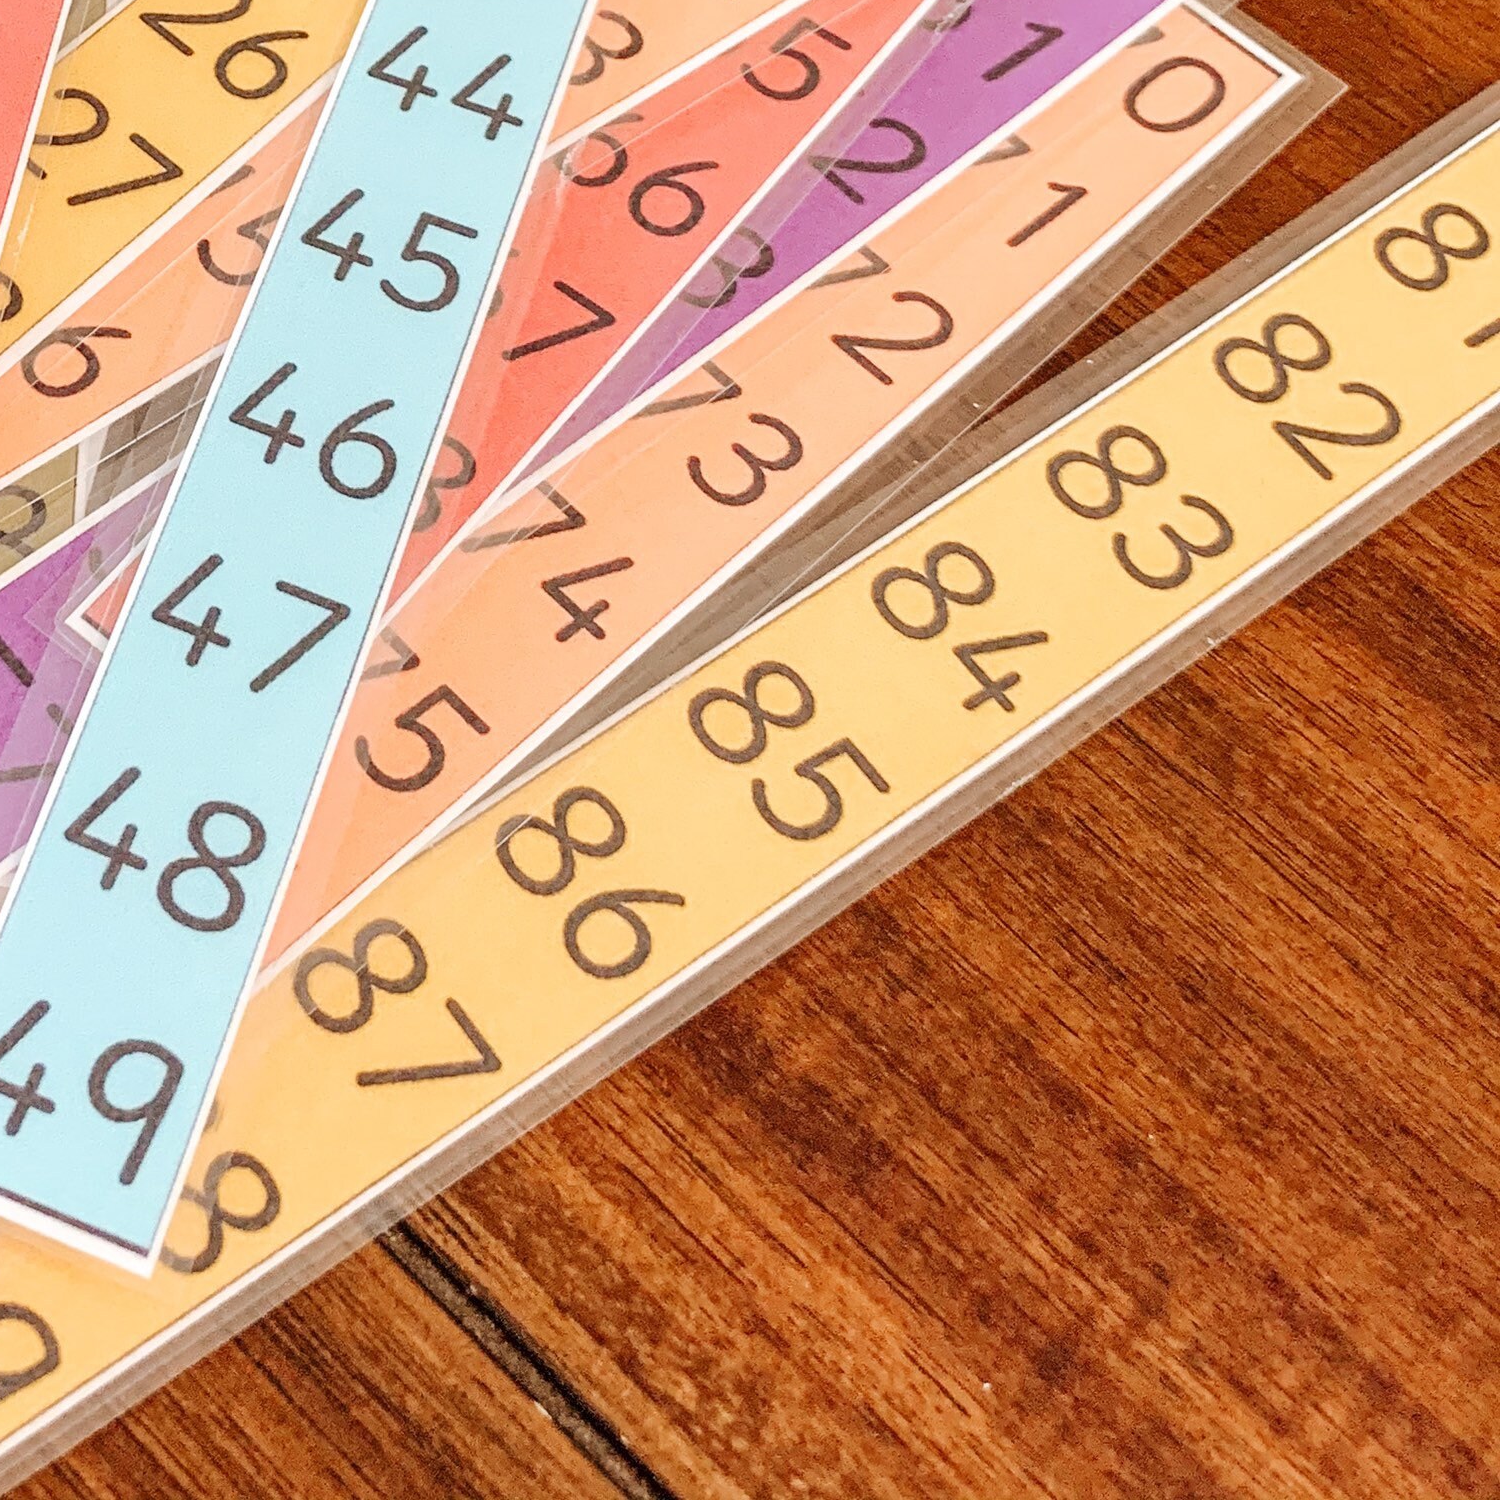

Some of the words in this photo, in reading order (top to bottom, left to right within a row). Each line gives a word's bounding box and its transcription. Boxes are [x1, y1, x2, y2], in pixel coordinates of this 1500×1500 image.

[366, 25, 524, 141] 44
[568, 10, 645, 87] 3
[740, 16, 853, 102] 5
[1122, 22, 1227, 134] 0
[809, 117, 927, 204] 2
[301, 188, 479, 313] 45
[21, 324, 132, 399] 6
[502, 280, 617, 361] 7
[228, 362, 397, 501] 46
[1212, 312, 1403, 481] 82
[458, 479, 636, 644] 74
[1045, 424, 1235, 591] 83
[151, 553, 351, 693] 47
[870, 540, 1049, 714] 84
[687, 660, 890, 842] 85
[63, 766, 268, 933] 48
[496, 784, 687, 979] 86
[293, 917, 503, 1089] 87
[158, 1148, 283, 1275] 8
